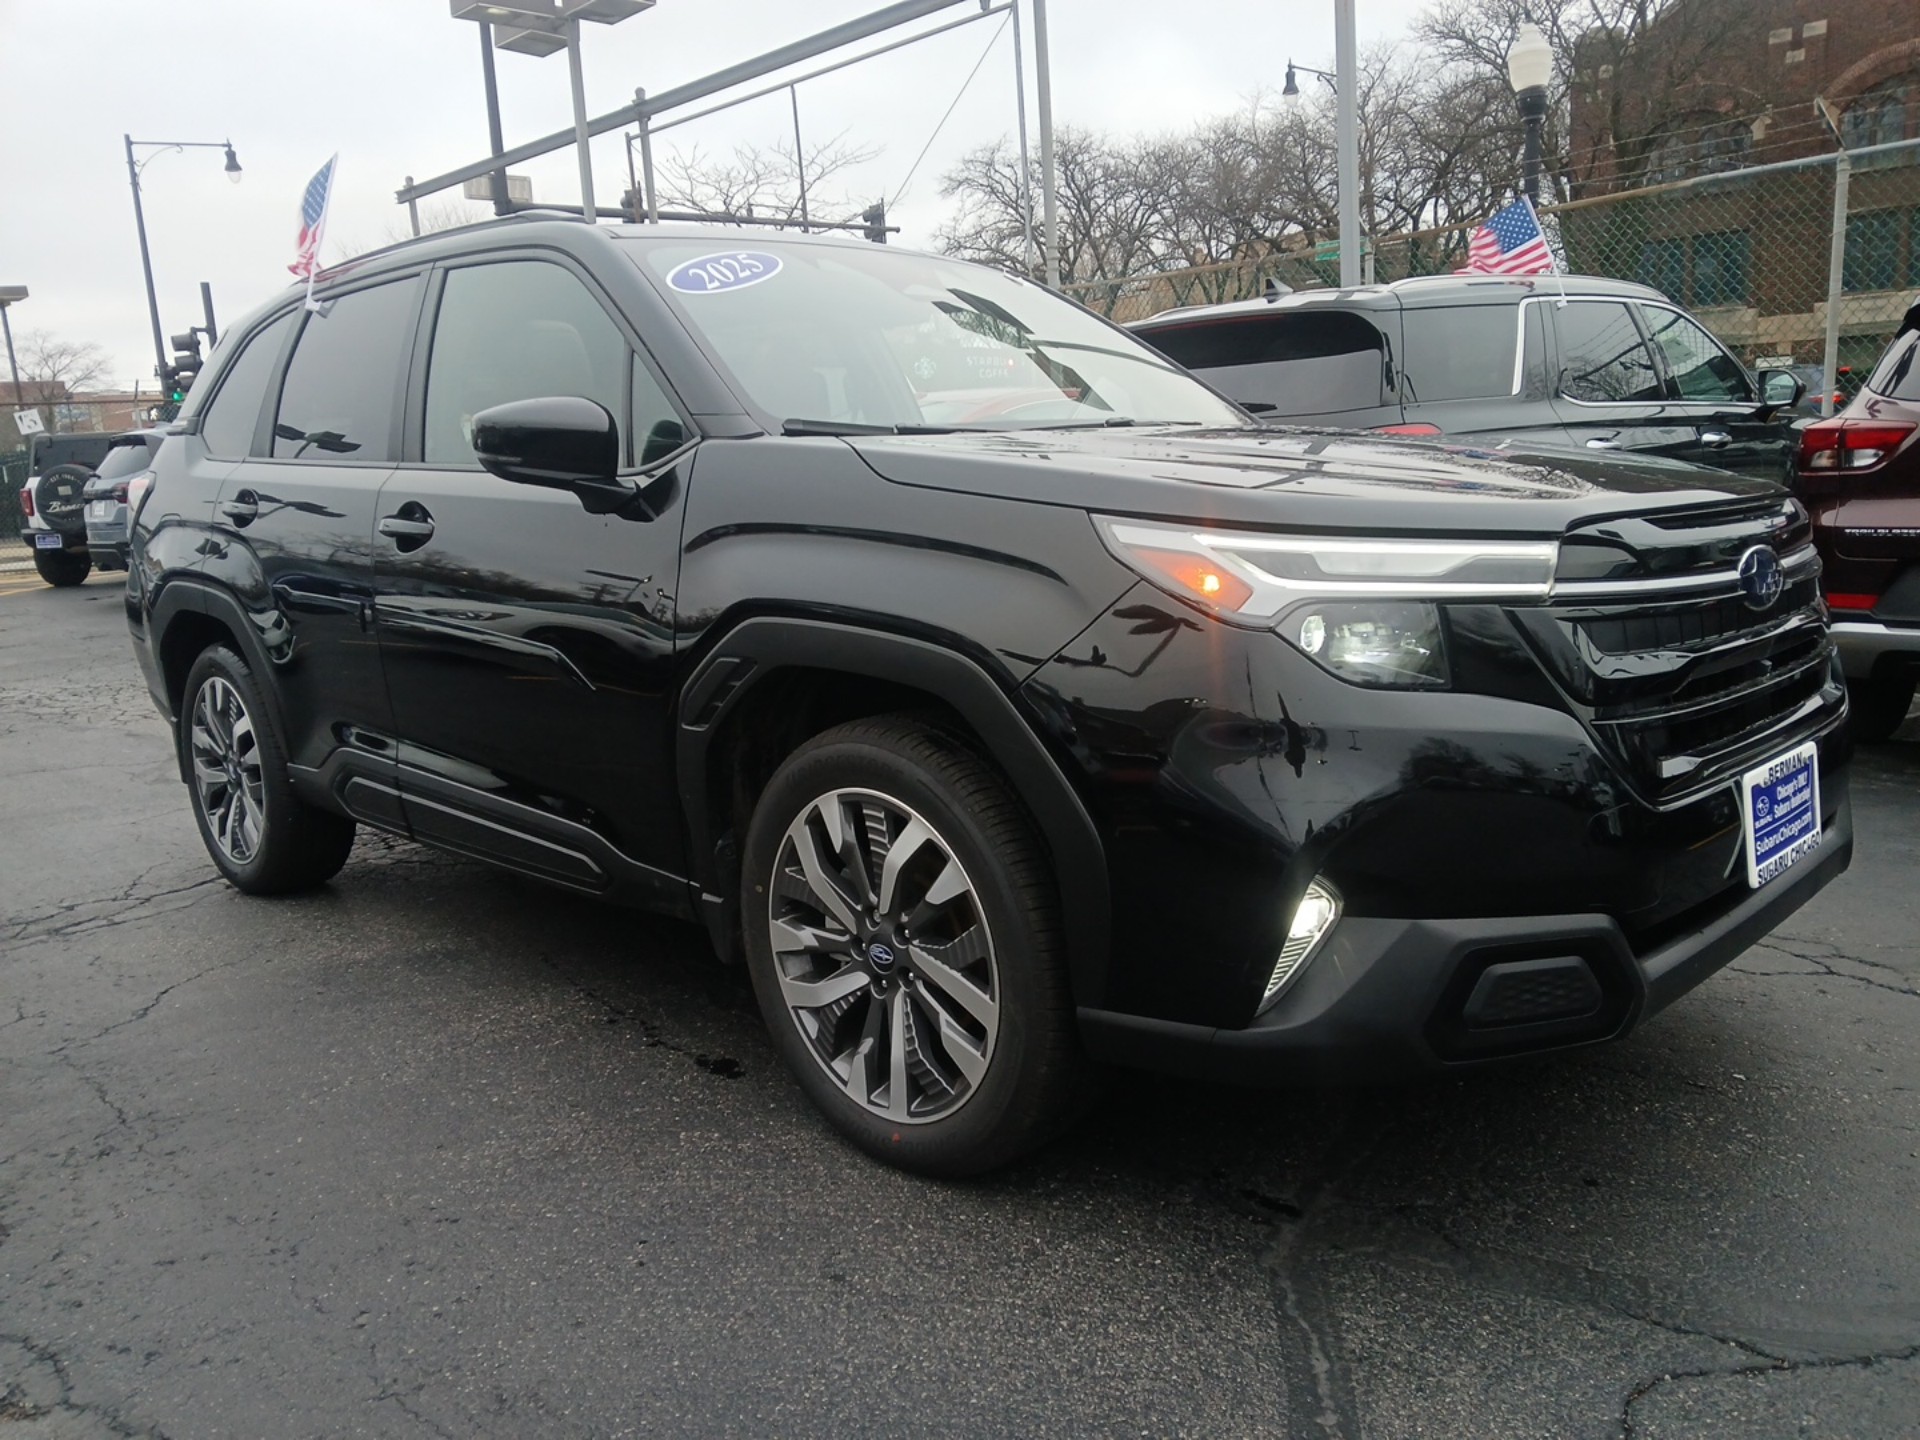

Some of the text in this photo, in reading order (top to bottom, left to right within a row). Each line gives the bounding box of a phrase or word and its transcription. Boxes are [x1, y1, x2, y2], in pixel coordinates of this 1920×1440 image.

[688, 252, 764, 290] 2025
[966, 355, 1025, 367] STARBUS
[1768, 752, 1803, 783] BERMAN
[1756, 811, 1812, 856] SubaruChicago.com
[1757, 831, 1821, 885] SUBARU CHICAGO
